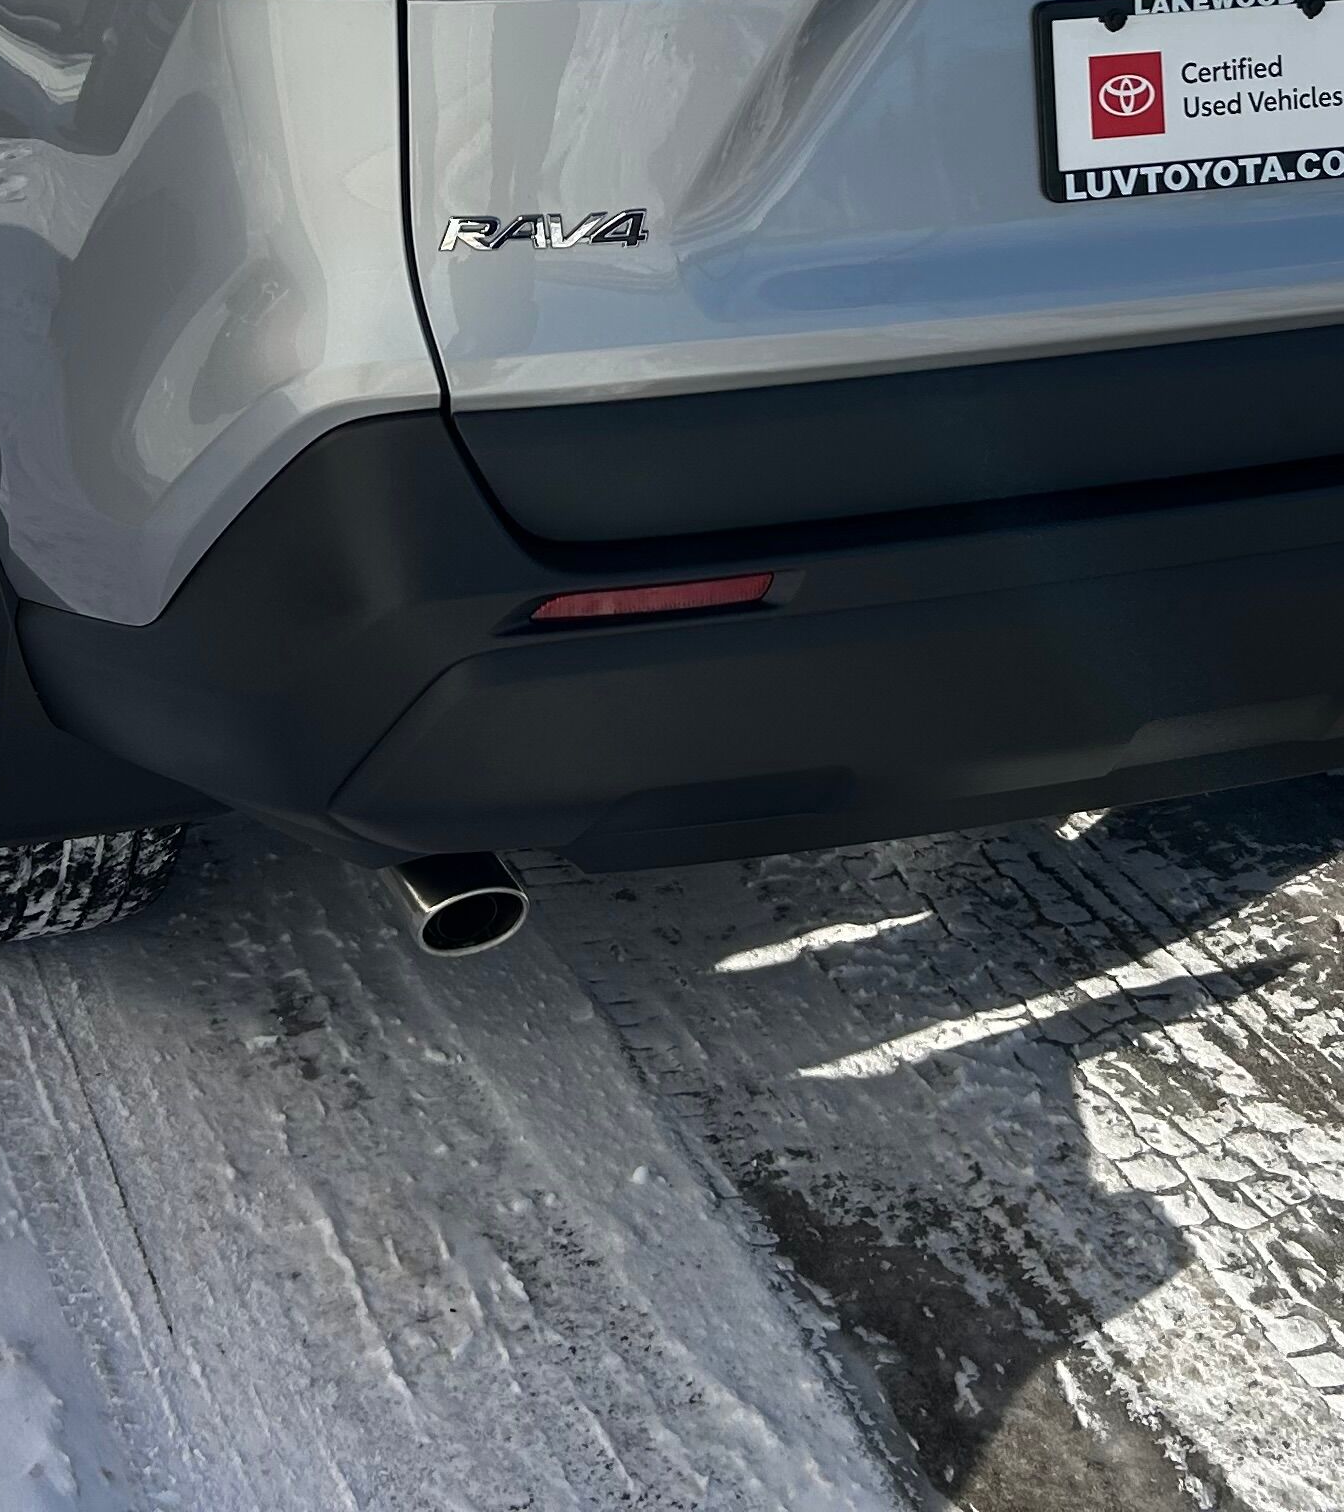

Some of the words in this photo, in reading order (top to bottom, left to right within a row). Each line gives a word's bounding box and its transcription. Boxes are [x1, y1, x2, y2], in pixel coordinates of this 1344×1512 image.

[1181, 55, 1283, 84] Certified
[1183, 91, 1241, 118] Used
[1248, 86, 1343, 113] Vehicles
[438, 208, 649, 251] RAV4
